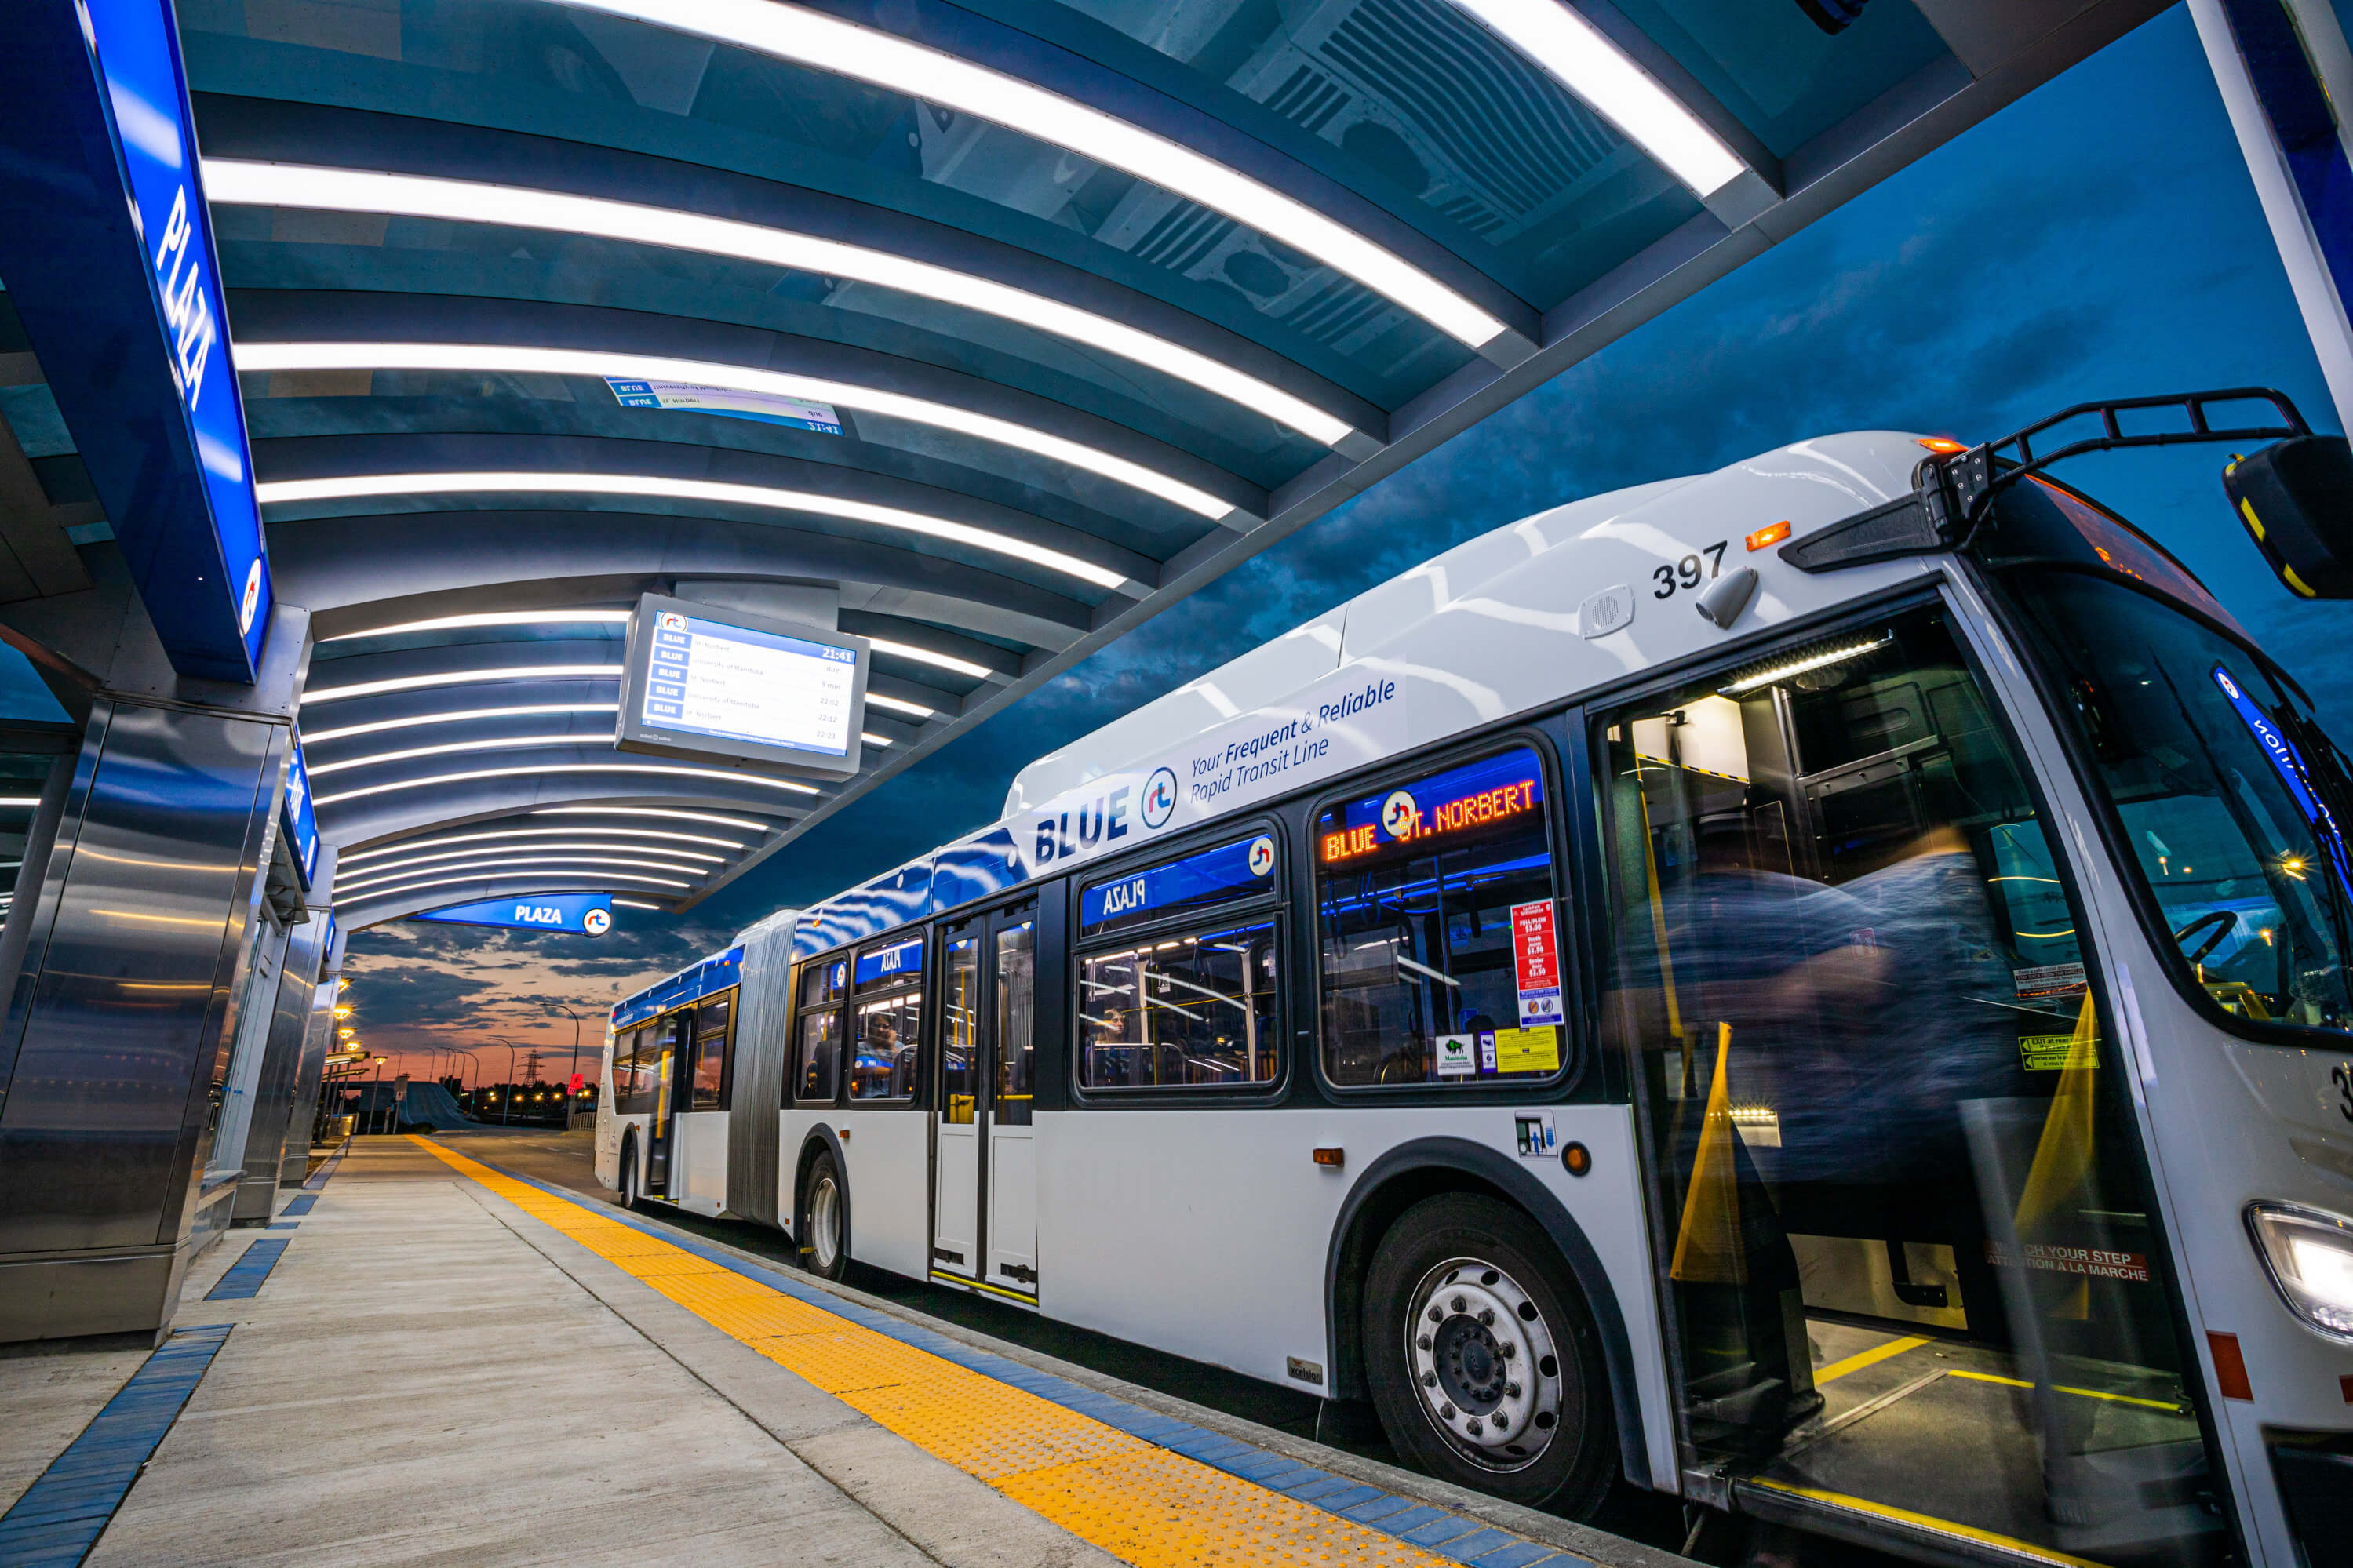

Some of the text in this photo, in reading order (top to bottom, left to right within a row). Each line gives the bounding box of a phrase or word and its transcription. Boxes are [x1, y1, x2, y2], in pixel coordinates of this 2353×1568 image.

[156, 184, 211, 412] PLAZA
[1653, 540, 1728, 599] 397
[663, 633, 686, 644] BLUE
[661, 650, 683, 661] BLUE
[822, 648, 852, 662] 21:41
[658, 668, 681, 678] BLUE
[656, 686, 679, 697] BLUE
[653, 704, 676, 714] BLUE
[1192, 679, 1396, 778] Your Frequent & Reliable
[1190, 738, 1329, 804] Rapid Transit Line
[1035, 785, 1130, 868] BLUE
[1326, 824, 1377, 861] BLUE
[1437, 780, 1534, 832] NORBERT
[515, 905, 562, 924] PLAZA
[2046, 1246, 2089, 1261] YOUR
[2092, 1250, 2131, 1264] STEP
[2068, 1263, 2085, 1273] LA
[2089, 1264, 2148, 1281] MARCHE
